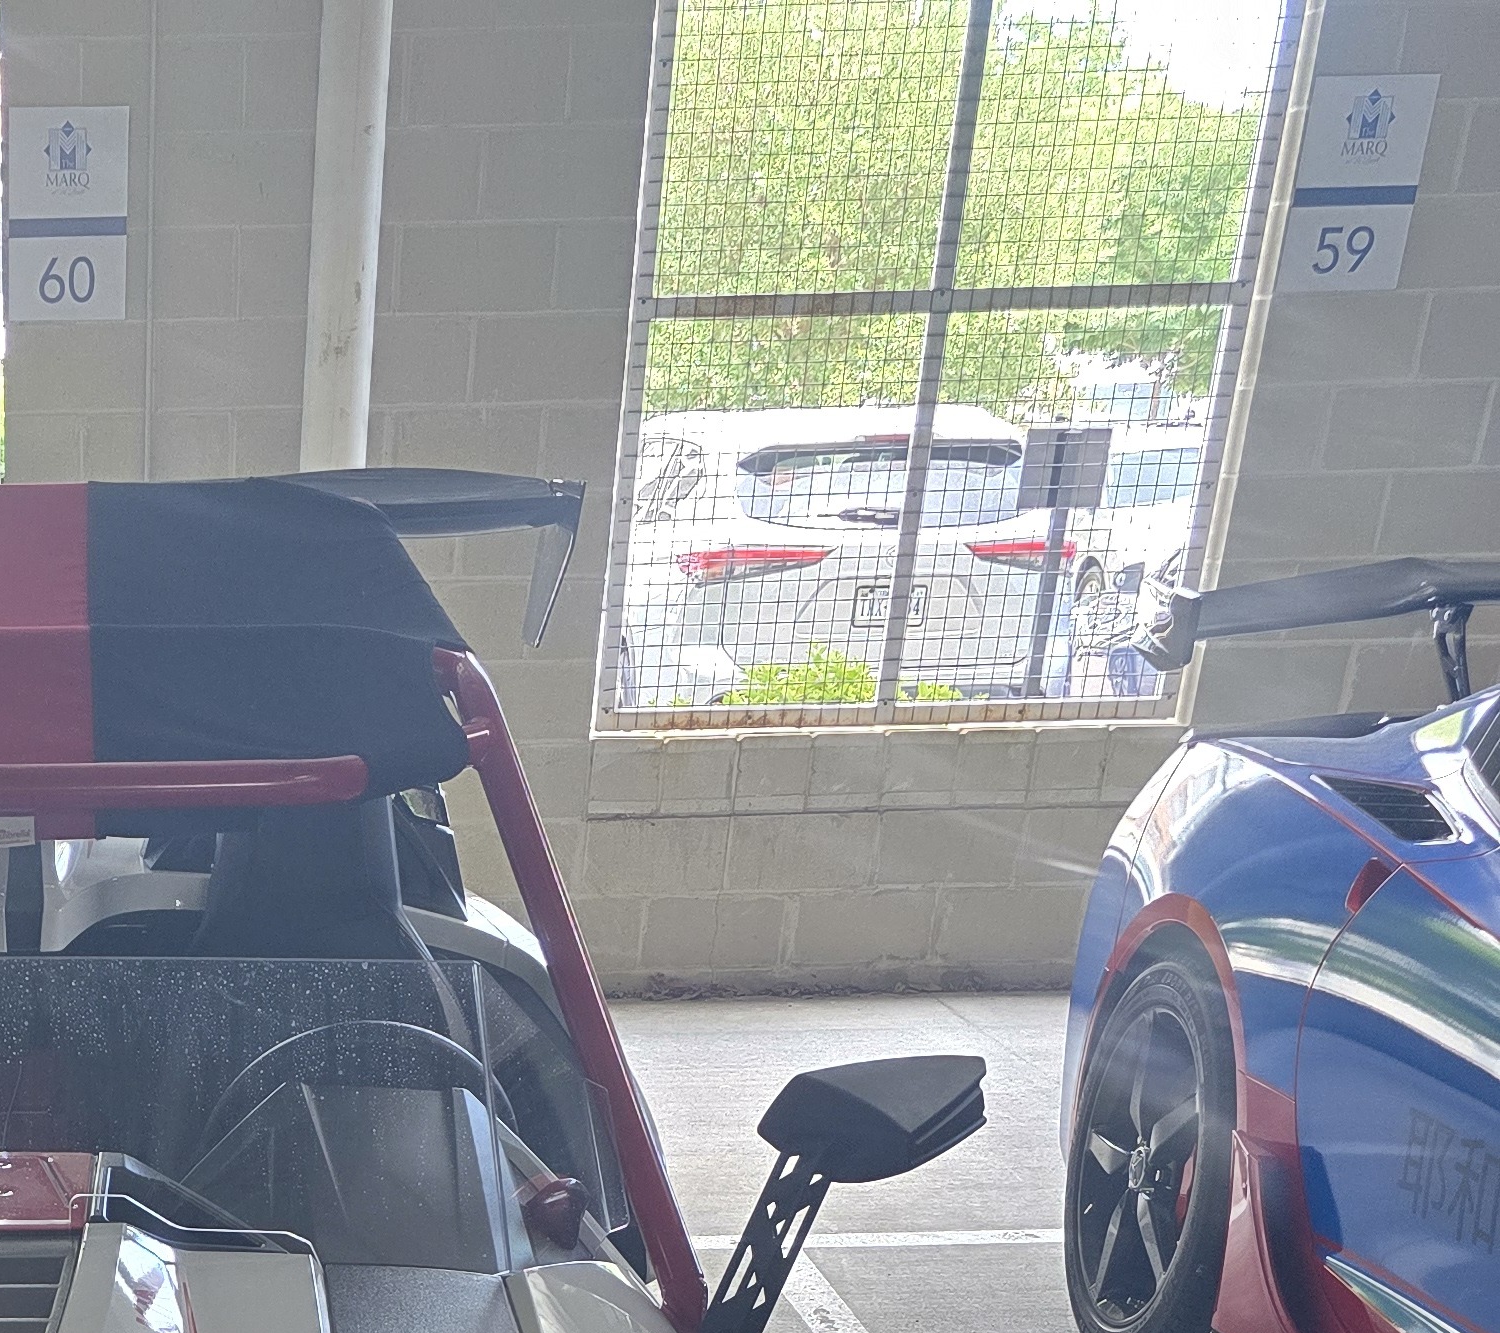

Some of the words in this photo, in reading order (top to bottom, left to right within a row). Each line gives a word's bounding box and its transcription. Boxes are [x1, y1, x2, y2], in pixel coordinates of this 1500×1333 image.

[1340, 140, 1387, 157] MARQ
[44, 171, 91, 190] MARQ
[1311, 225, 1375, 275] 59
[38, 256, 96, 304] 60
